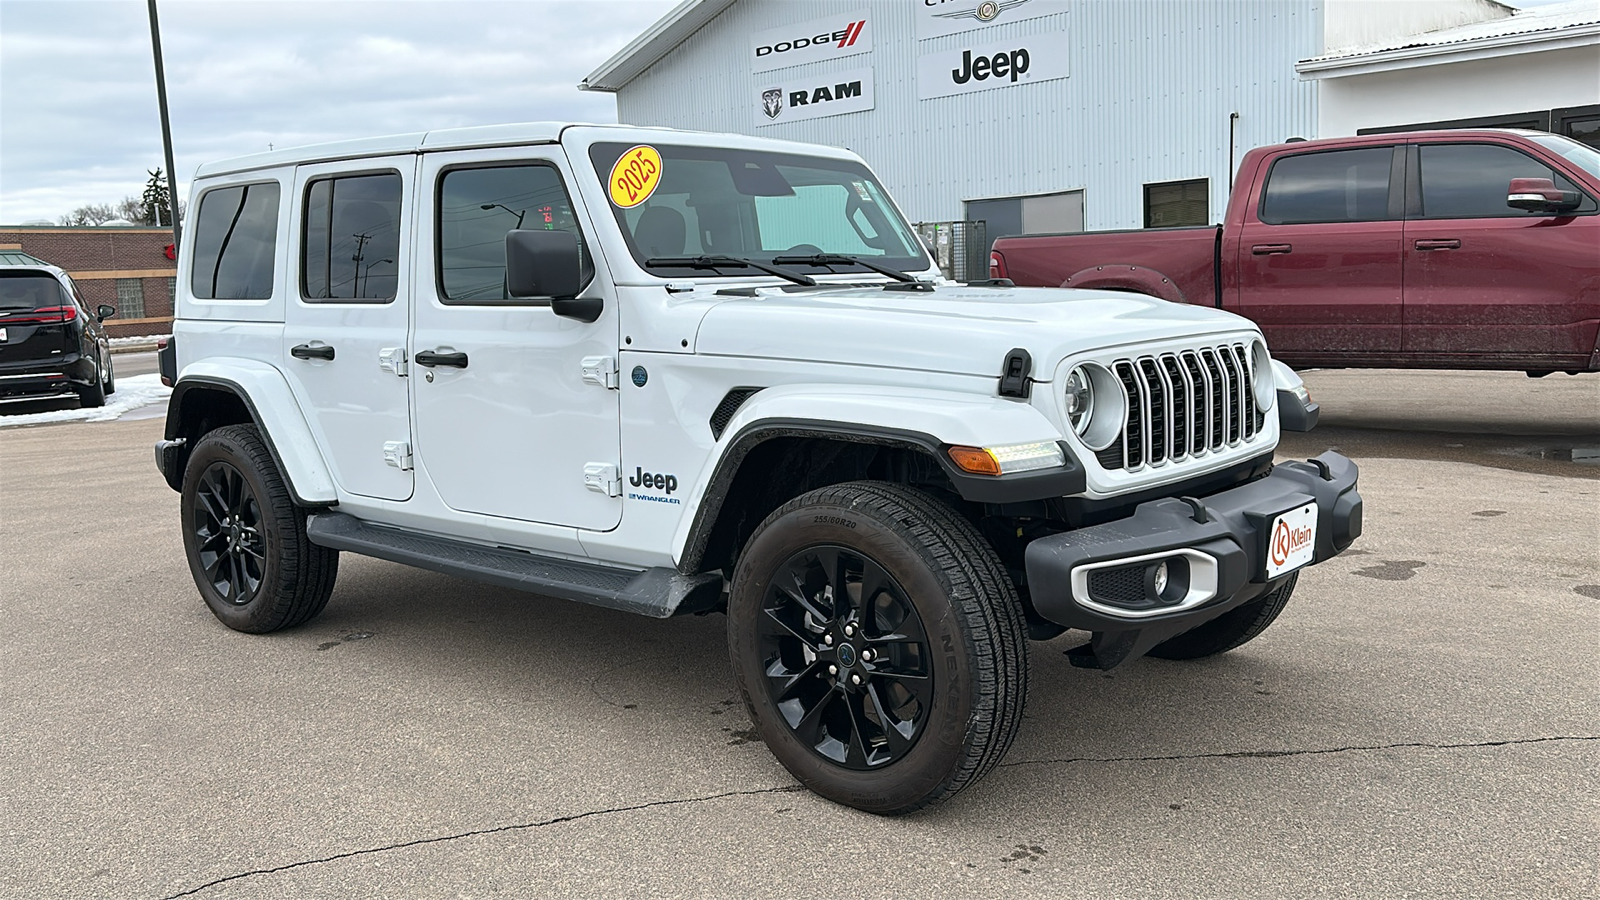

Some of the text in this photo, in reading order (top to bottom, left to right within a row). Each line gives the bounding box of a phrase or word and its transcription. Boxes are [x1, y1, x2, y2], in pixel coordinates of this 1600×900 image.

[756, 29, 849, 57] DODGE
[952, 48, 1030, 85] Jeep
[789, 80, 862, 107] RAM
[617, 150, 656, 202] 2025
[629, 466, 678, 495] Jeep
[636, 494, 681, 505] WRANGLER
[813, 515, 857, 529] 255/60R20
[1291, 524, 1312, 548] Klein
